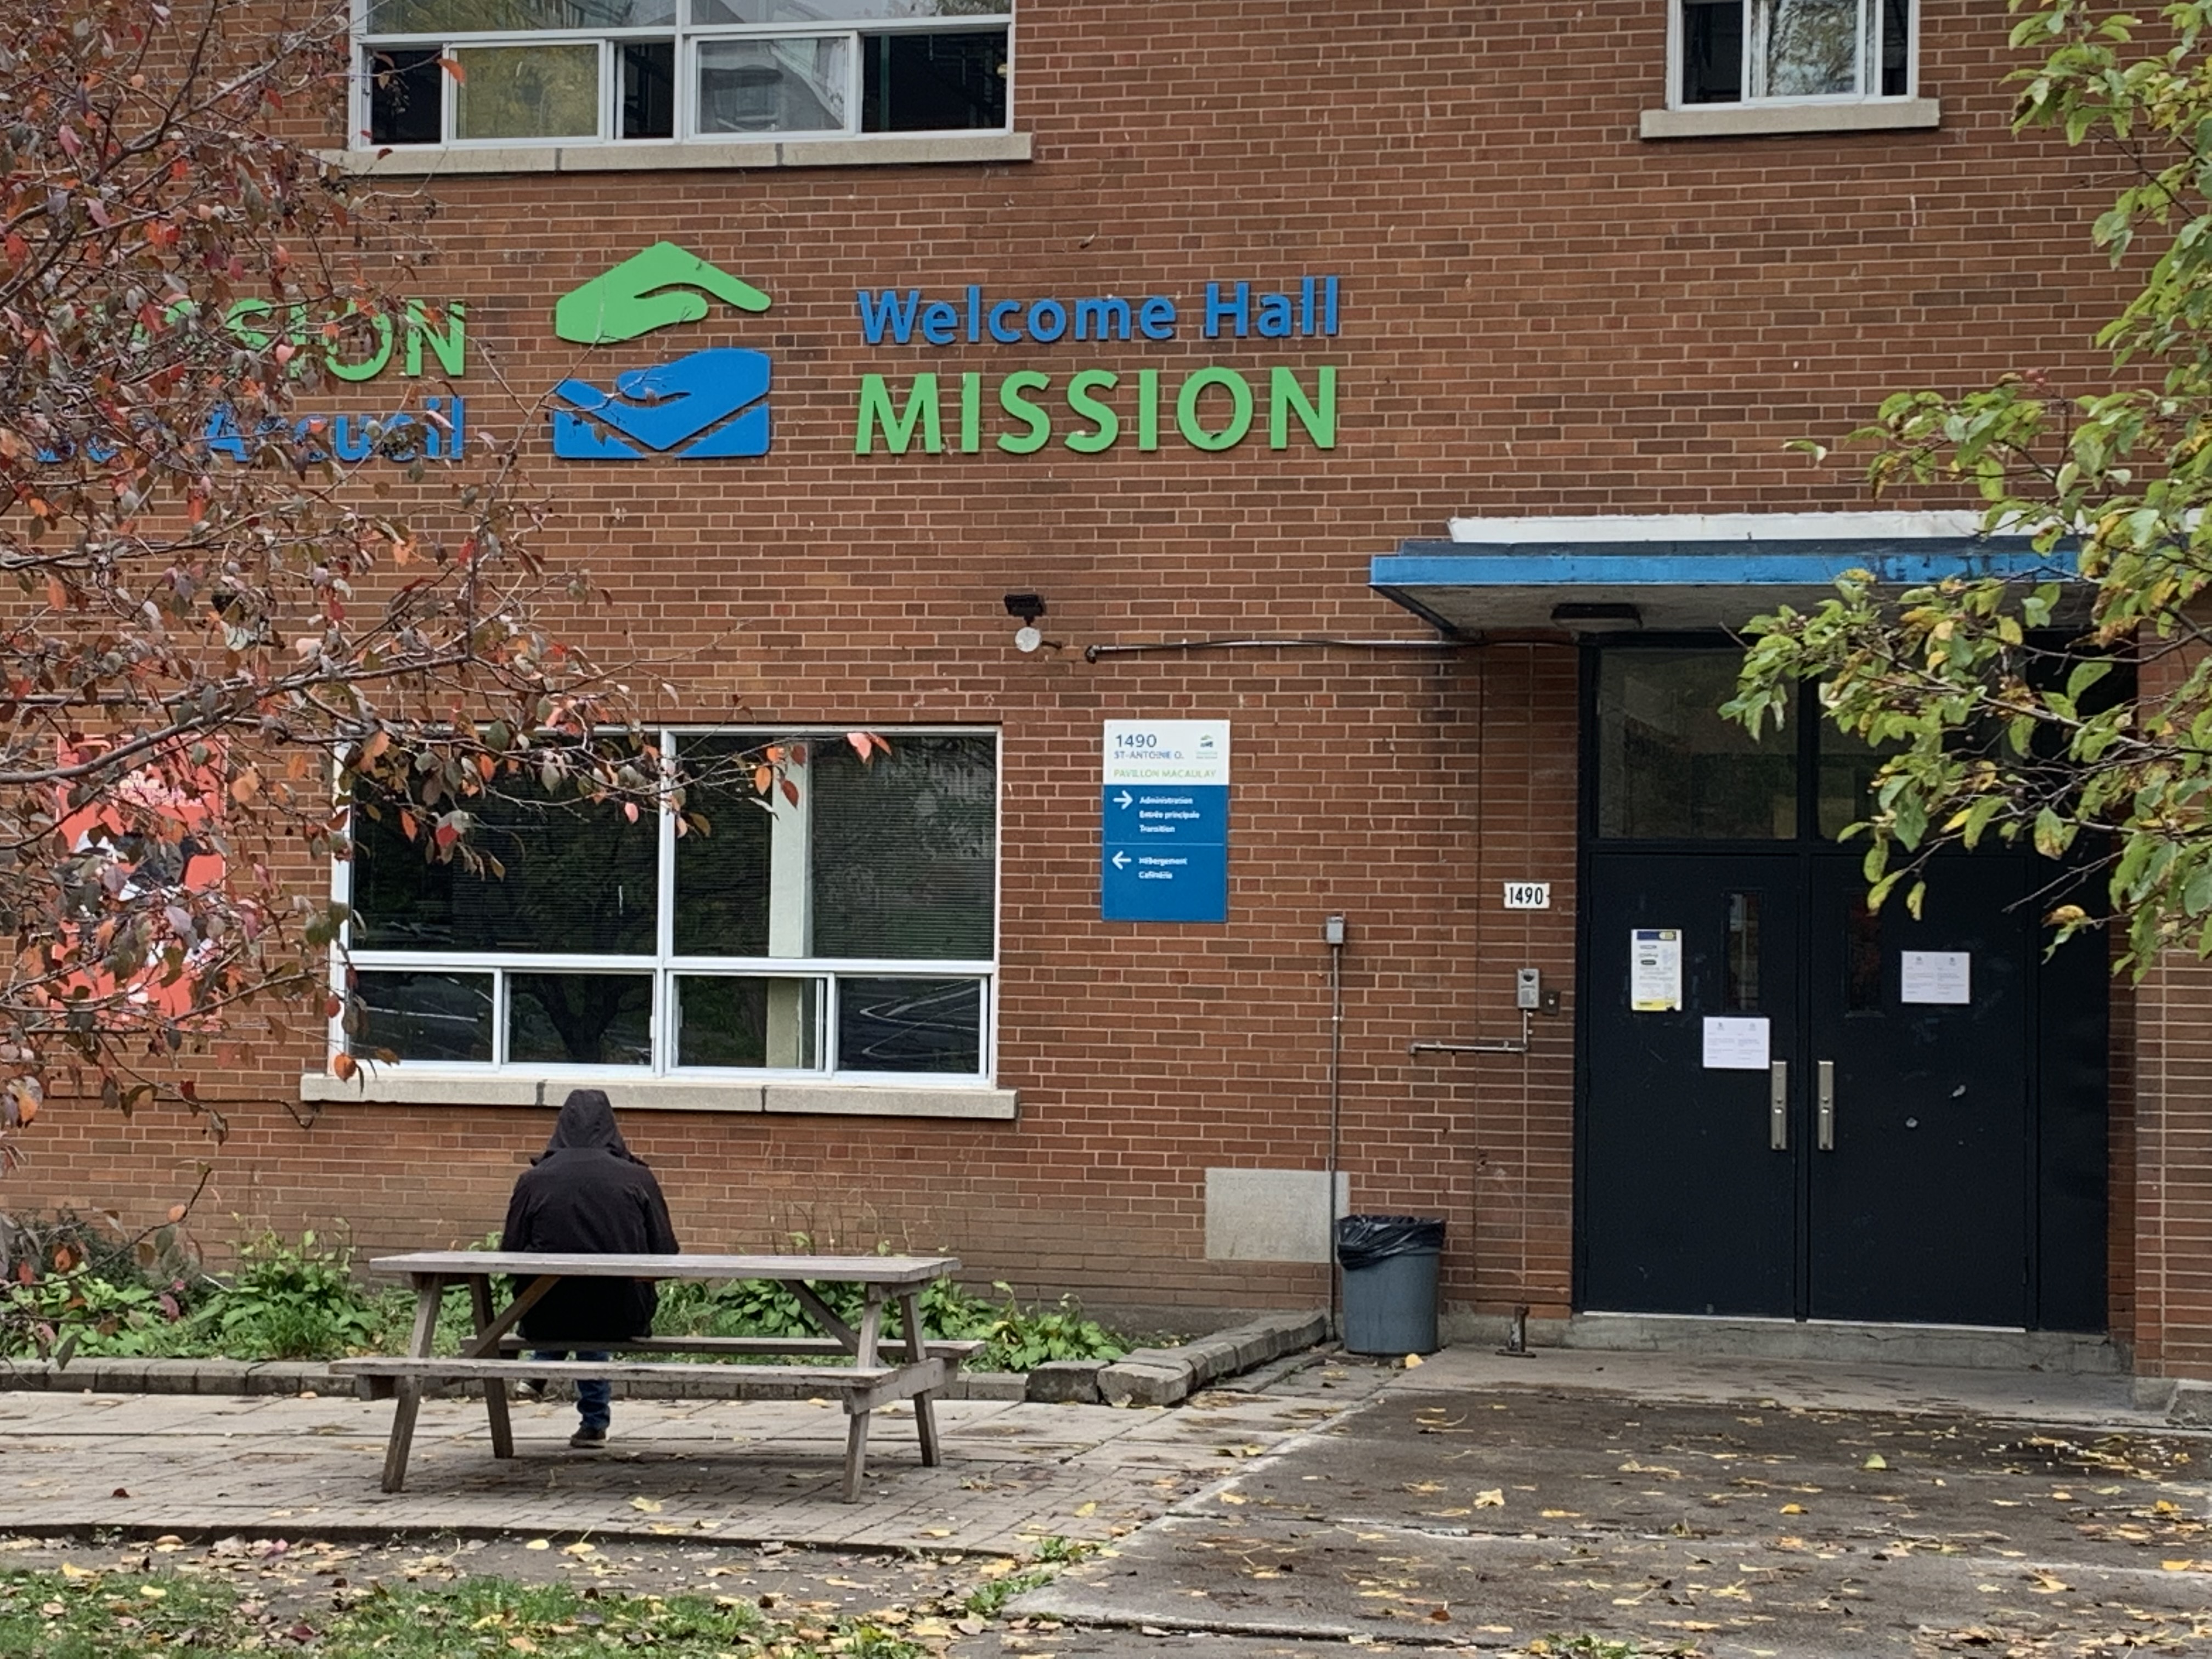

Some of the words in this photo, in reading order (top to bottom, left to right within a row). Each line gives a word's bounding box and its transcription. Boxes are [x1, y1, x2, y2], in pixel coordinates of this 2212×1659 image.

[856, 285, 1177, 345] Welcome
[1204, 275, 1339, 337] Hall
[855, 366, 1337, 456] MISSION
[1115, 734, 1157, 748] 1490
[1114, 751, 1171, 759] ST-ANTOINE
[1113, 769, 1160, 778] PAVILLON
[1161, 769, 1217, 778] MACAULAY
[1139, 796, 1194, 805] Administration
[1138, 810, 1164, 819] Entrée
[1164, 810, 1200, 820] principale
[1139, 824, 1176, 833] Transition
[1138, 856, 1188, 866] Hébergement
[1509, 887, 1543, 905] 1490
